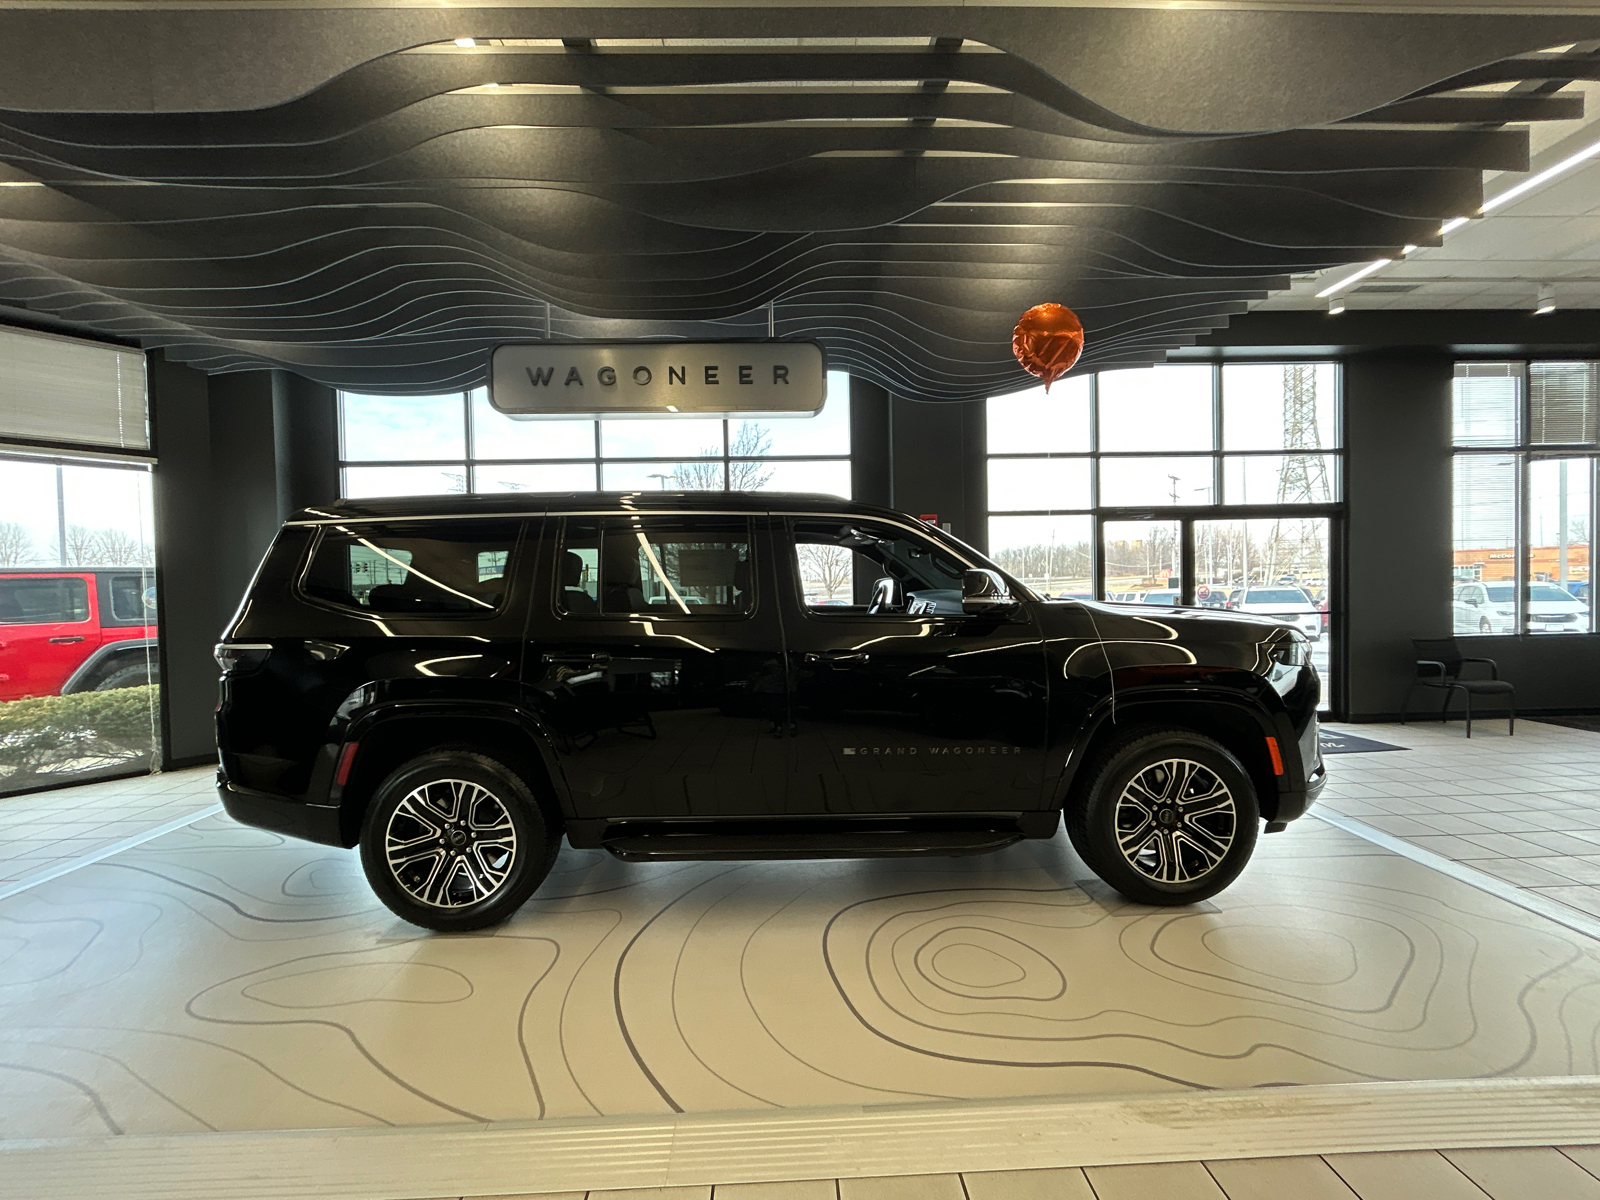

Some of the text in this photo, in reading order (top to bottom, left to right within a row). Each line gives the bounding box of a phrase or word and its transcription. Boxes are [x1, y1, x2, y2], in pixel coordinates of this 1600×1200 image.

[525, 365, 790, 386] WAGONEER
[860, 746, 1021, 755] GRAND WAGONEER
